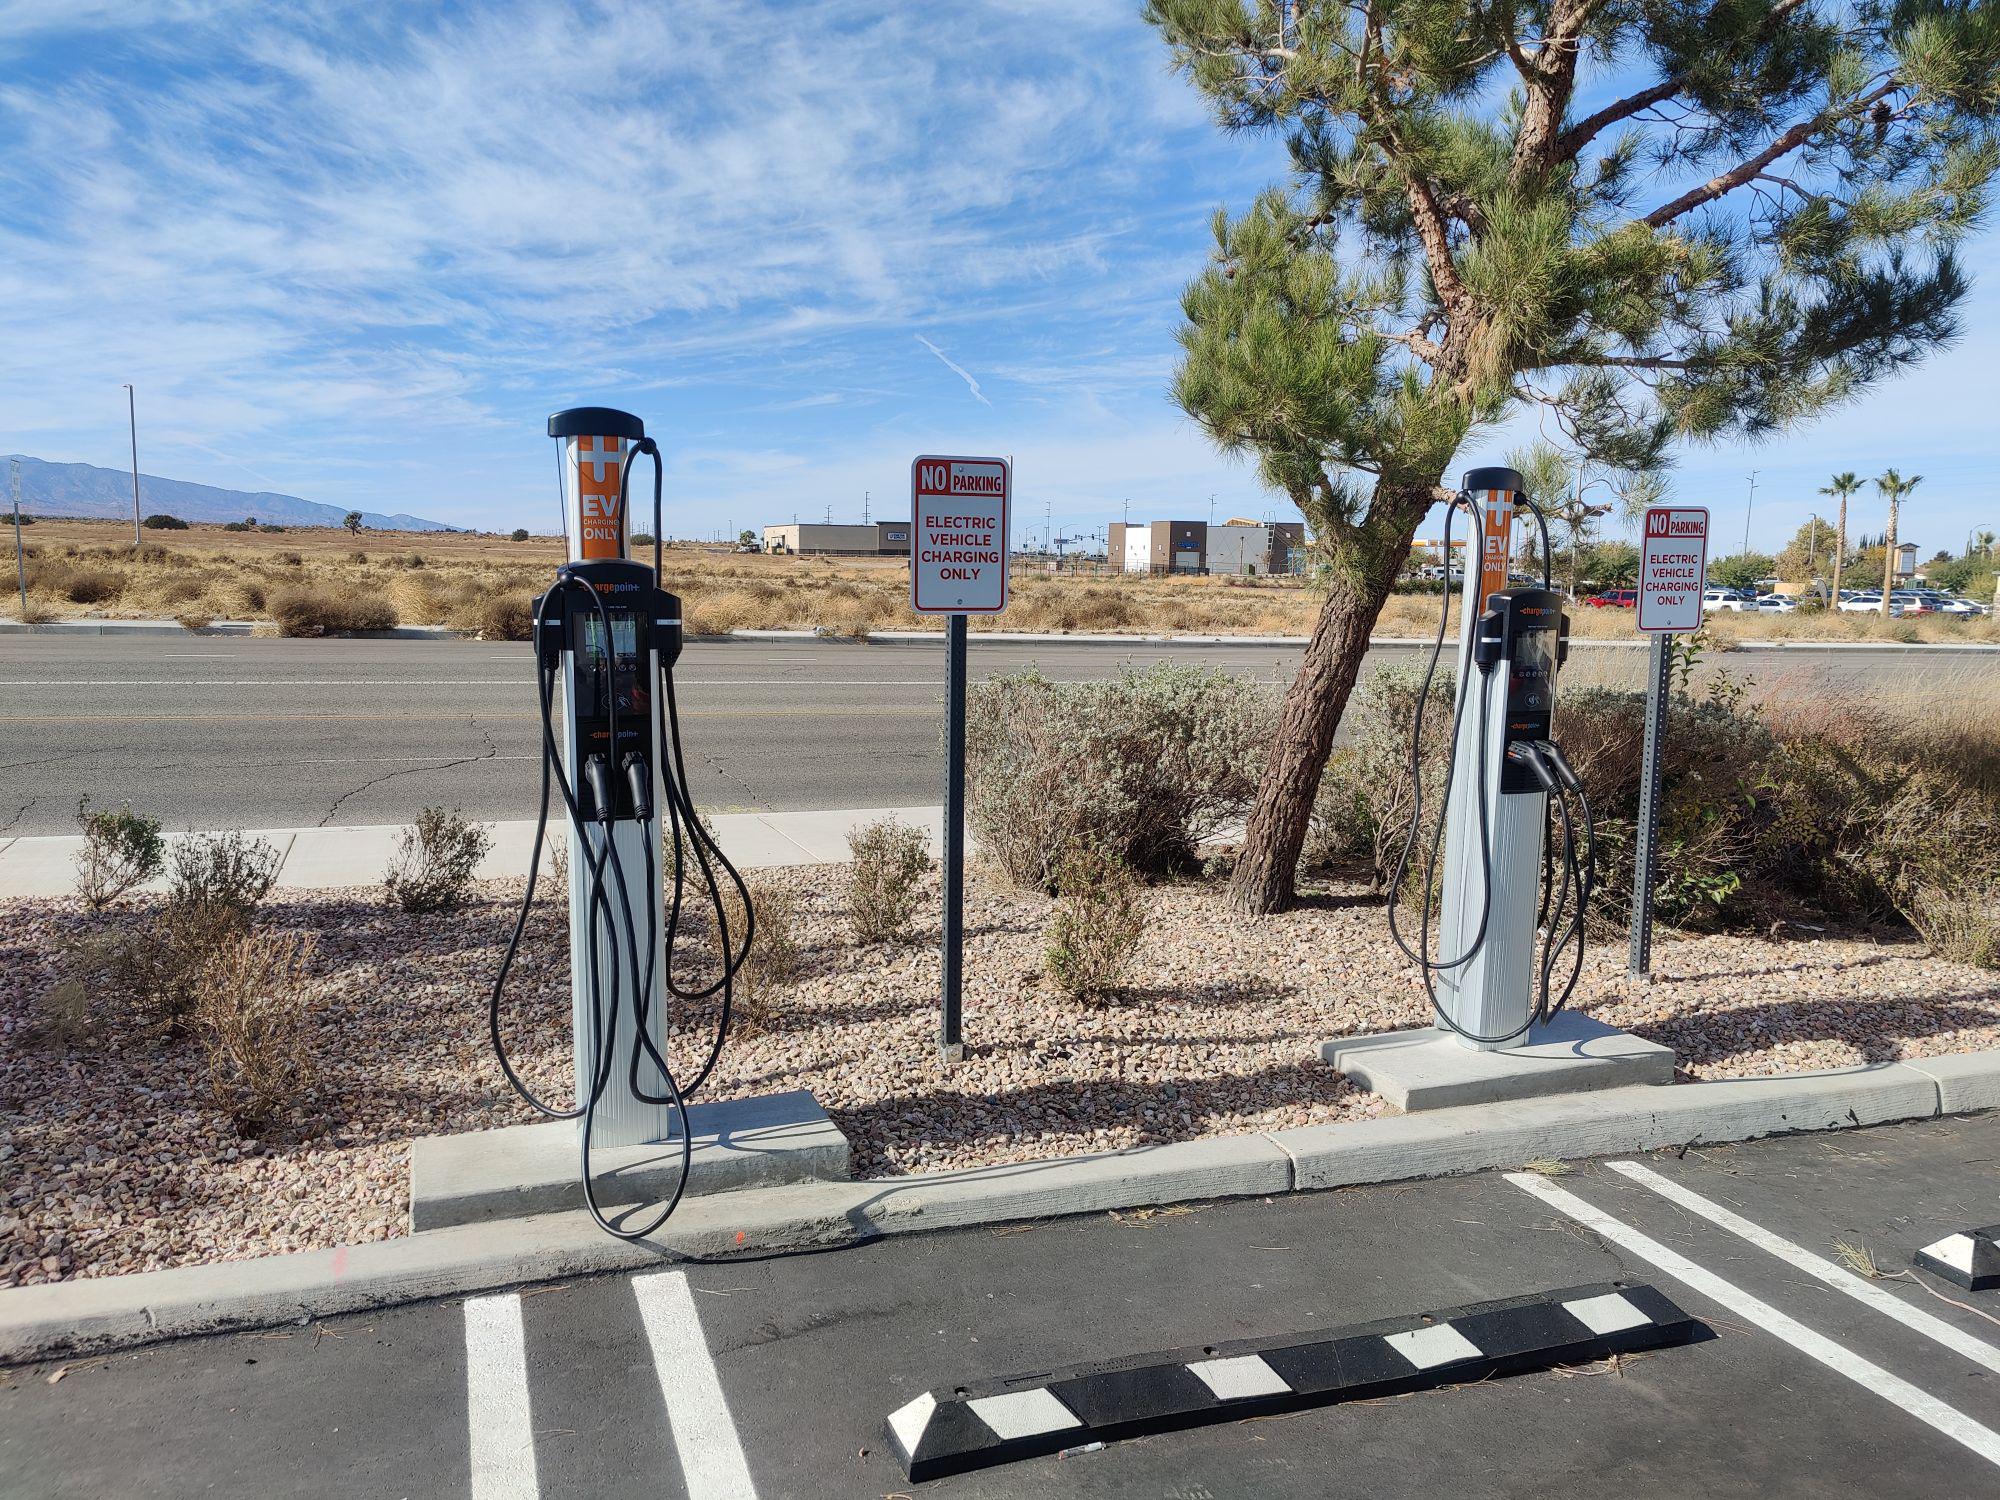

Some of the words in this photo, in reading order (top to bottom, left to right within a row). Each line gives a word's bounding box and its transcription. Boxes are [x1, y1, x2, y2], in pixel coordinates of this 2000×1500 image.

[921, 465, 947, 491] NO
[953, 475, 1001, 492] PARKING
[583, 495, 618, 517] EV
[583, 518, 620, 526] CHARGING
[925, 515, 996, 529] ELECTRIC
[1649, 514, 1667, 534] NO
[1670, 521, 1704, 534] PARKING
[583, 527, 618, 540] ONLY
[929, 533, 992, 547] VEHICLE
[1485, 535, 1507, 554] EV
[921, 550, 999, 563] CHARGING
[1650, 554, 1698, 564] ELECTRIC
[1484, 562, 1506, 572] ONLY
[1652, 568, 1694, 578] VEHICLE
[940, 568, 981, 580] ONLY
[1645, 582, 1699, 592] CHARGING
[1657, 595, 1686, 606] ONLY
